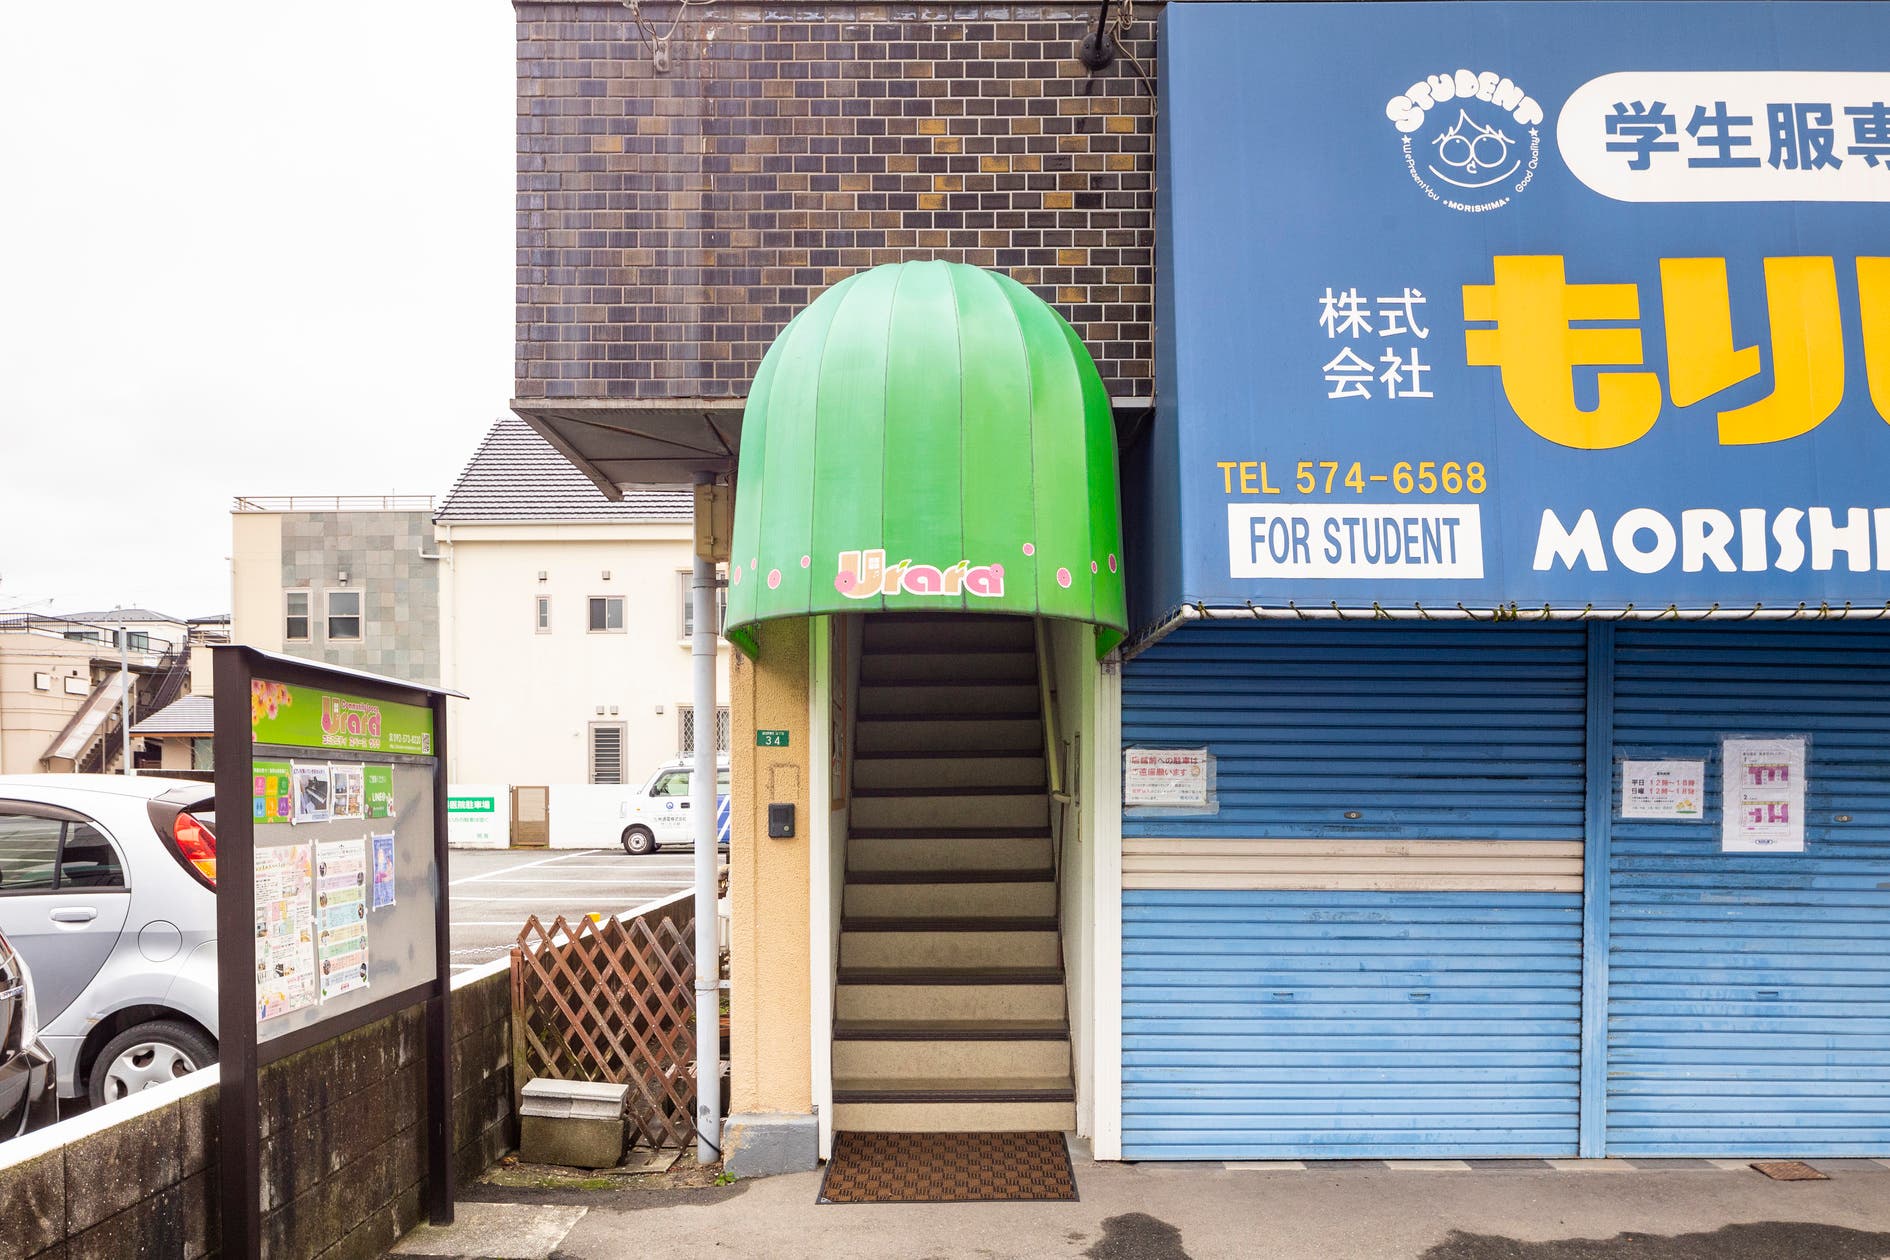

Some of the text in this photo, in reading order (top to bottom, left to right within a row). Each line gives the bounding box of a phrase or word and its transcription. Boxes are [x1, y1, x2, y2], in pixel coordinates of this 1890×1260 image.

[1386, 69, 1544, 133] STUDENT
[1515, 136, 1541, 193] Good Quality
[1448, 199, 1507, 213] MORISHIMA
[1318, 287, 1430, 339] 株式
[1322, 346, 1434, 400] 会社
[1462, 254, 1890, 450] もり
[1218, 461, 1487, 495] TEL 574-6568
[1250, 517, 1460, 565] FOR STUDENT
[834, 549, 1005, 599] Urara
[321, 696, 382, 737] Urara
[765, 736, 780, 745] 34
[448, 800, 491, 810] 医院駐車場
